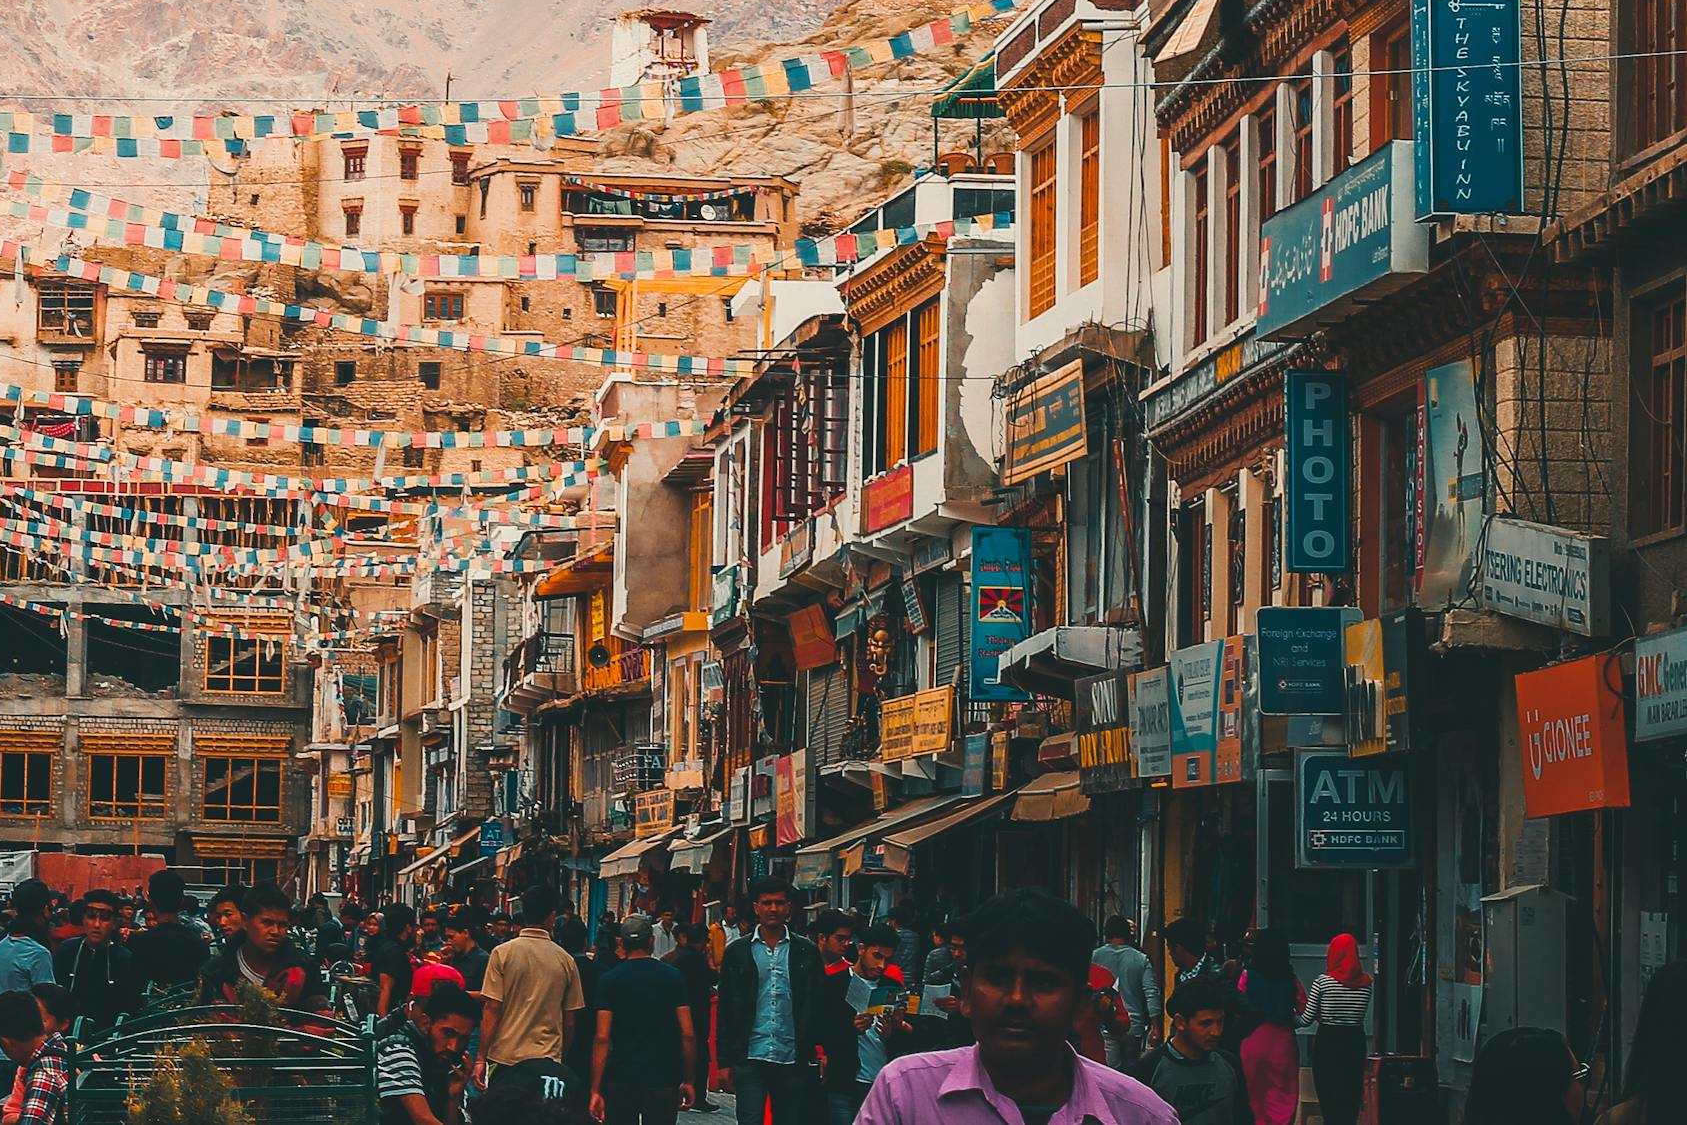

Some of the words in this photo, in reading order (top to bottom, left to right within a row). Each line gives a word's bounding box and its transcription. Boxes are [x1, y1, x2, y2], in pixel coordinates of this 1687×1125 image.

[1334, 200, 1360, 254] HDFC
[1361, 183, 1389, 240] BANK
[1301, 381, 1337, 559] PHOTO
[1416, 410, 1425, 492] PHOTO
[1415, 503, 1424, 564] SHOP
[1486, 548, 1522, 586] TSERING
[1524, 558, 1587, 602] ELECTRONICS
[1261, 628, 1294, 641] Foreign
[1290, 642, 1309, 654] and
[1079, 732, 1099, 768] DRY
[1543, 713, 1593, 764] GIONEE
[1309, 770, 1405, 805] ATM
[1322, 810, 1338, 823] 24
[1341, 810, 1392, 823] HOURS
[1330, 835, 1362, 844] HDFC
[1365, 835, 1399, 845] BANK
